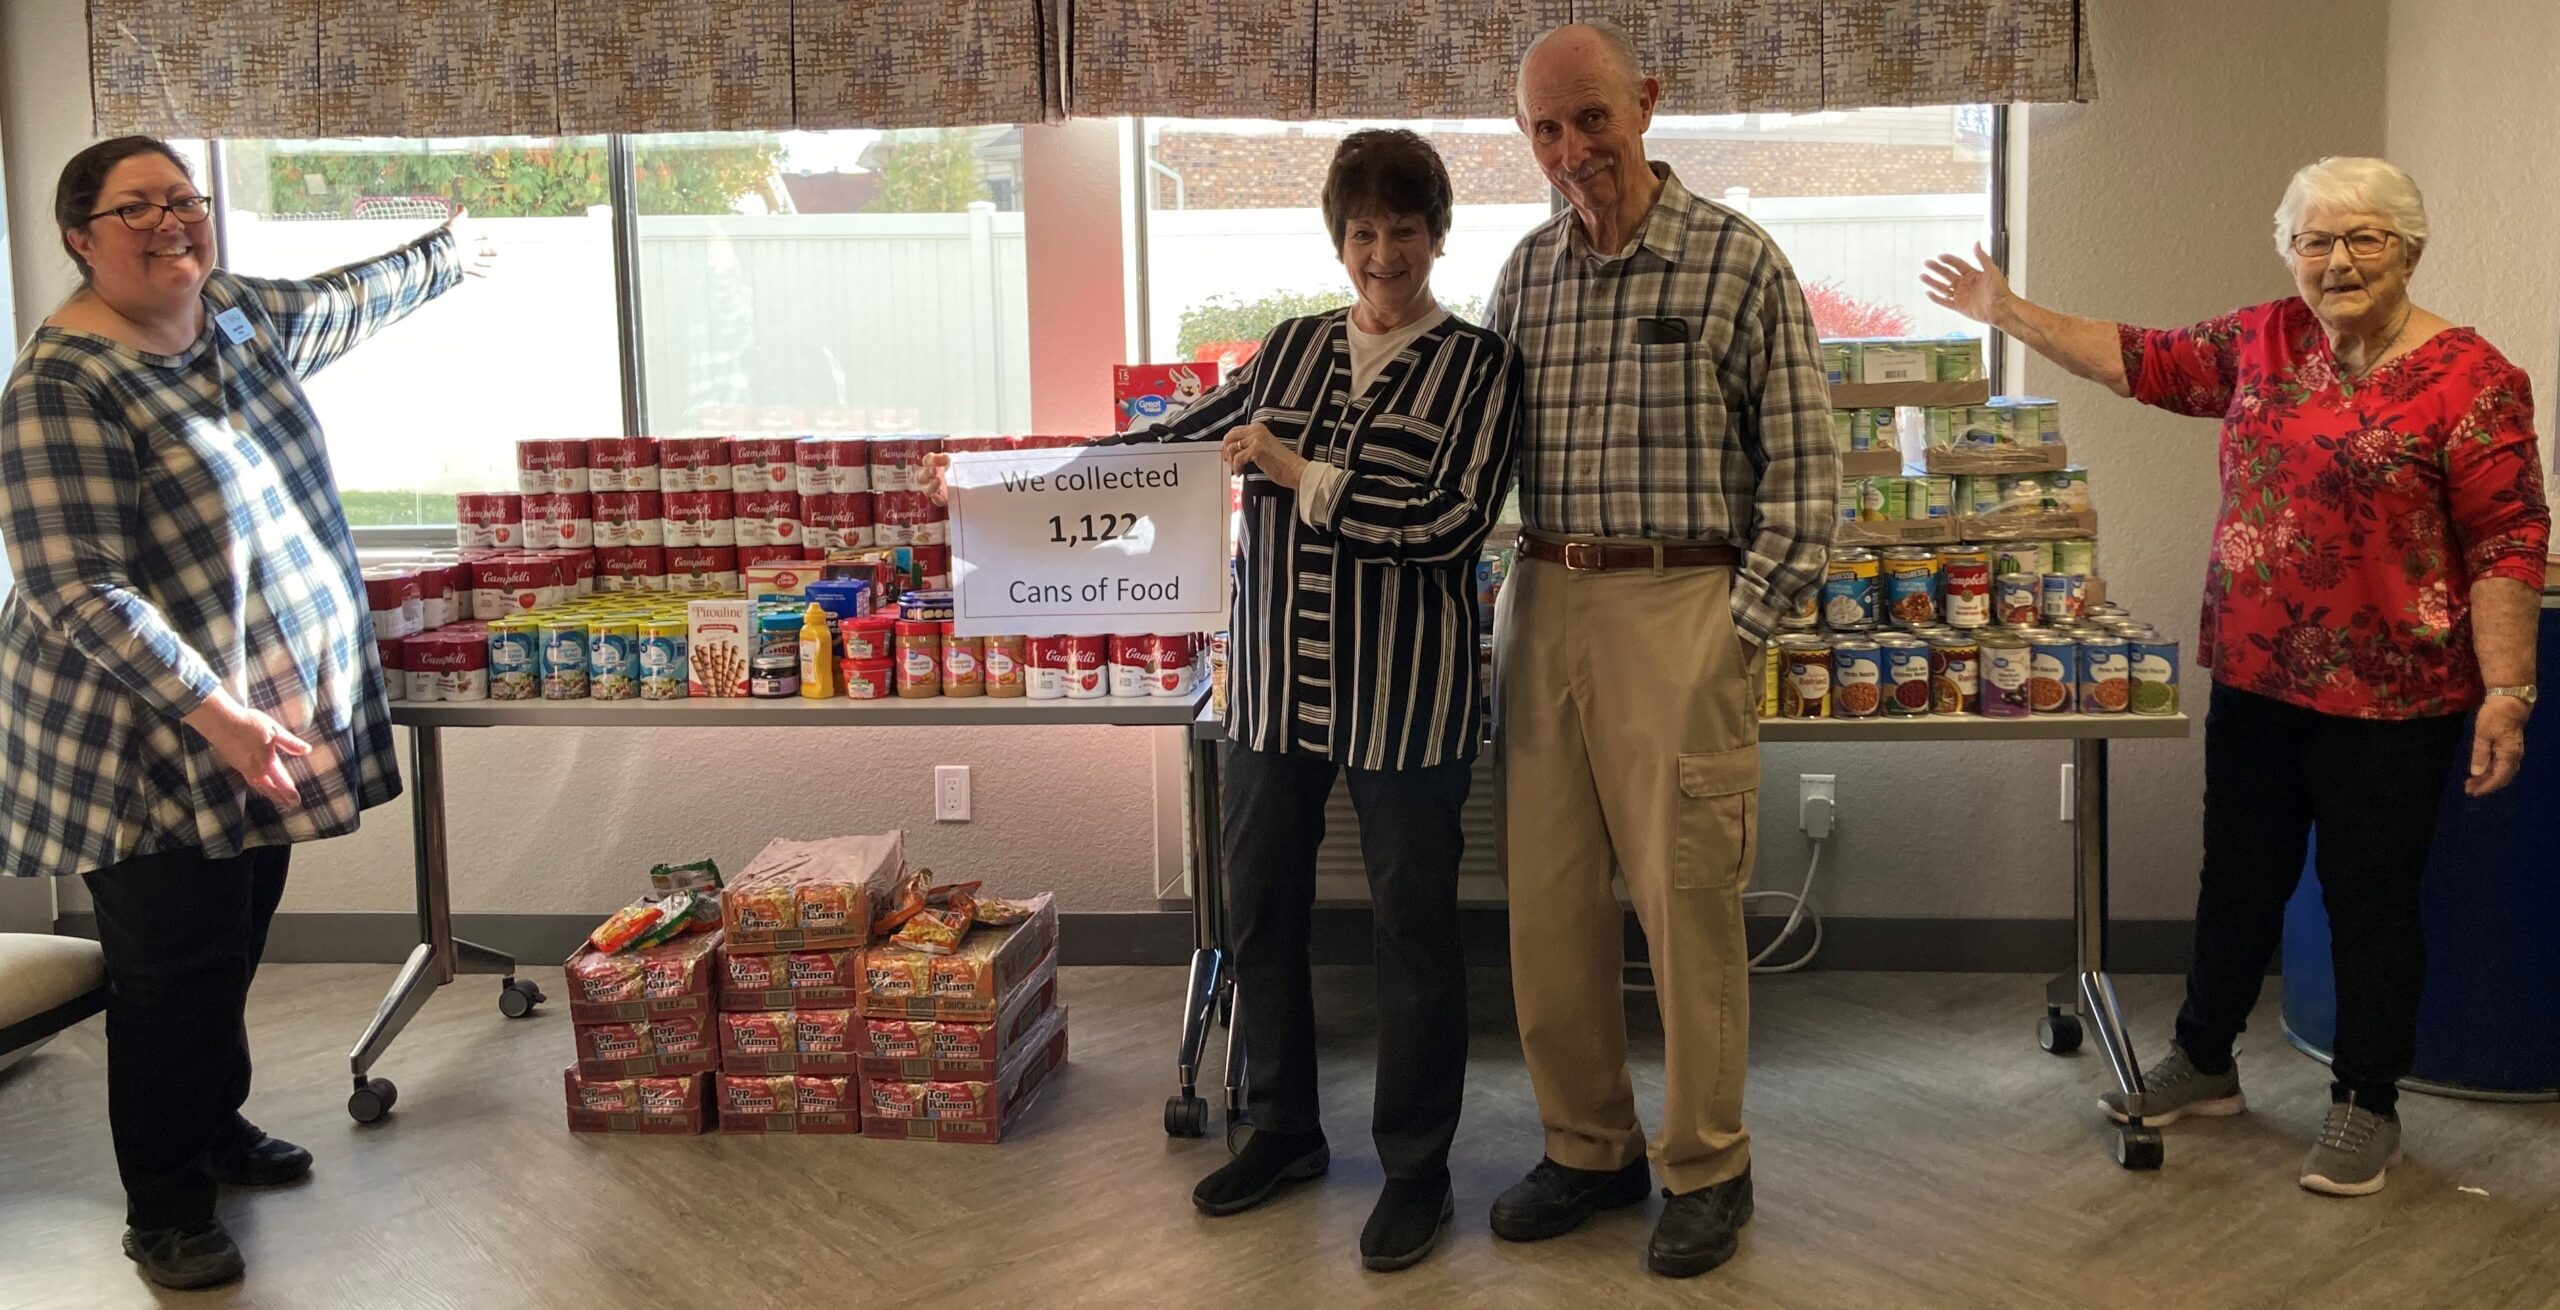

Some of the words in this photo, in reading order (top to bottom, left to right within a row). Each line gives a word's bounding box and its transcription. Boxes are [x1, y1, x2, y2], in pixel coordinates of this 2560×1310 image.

[1000, 470, 1046, 494] We
[1054, 462, 1179, 492] collected
[1049, 512, 1140, 548] 1,122
[482, 570, 530, 588] Campbell's
[1009, 580, 1073, 604] Cans
[1081, 577, 1109, 603] of
[1117, 576, 1180, 602] Food
[692, 606, 742, 618] Pirouline
[803, 902, 823, 912] Top
[790, 961, 810, 970] Top
[733, 973, 768, 981] amen
[790, 971, 832, 979] Ramen
[934, 973, 953, 982] Top
[582, 979, 601, 989] Top
[933, 983, 975, 991] Ramen
[657, 1000, 681, 1009] BEEF
[654, 1026, 675, 1036] Top
[799, 1023, 820, 1032] Top
[735, 1028, 755, 1037] Top
[593, 1033, 612, 1042] Top
[655, 1033, 697, 1044] Ramen
[800, 1033, 841, 1042] Ramen
[872, 1033, 892, 1042] Top
[935, 1033, 957, 1042] Top
[667, 1043, 691, 1054] BEEF
[936, 1043, 978, 1051] Ramen
[604, 1051, 628, 1059] BEEF
[666, 1055, 689, 1064] BEEF
[944, 1062, 968, 1070] BEEF
[729, 1087, 750, 1097] Top
[800, 1088, 814, 1096] op
[872, 1088, 891, 1101] Top
[928, 1090, 949, 1101] Top
[800, 1097, 836, 1105] amen
[929, 1101, 972, 1109] Ramen
[946, 1123, 969, 1131] BEEF
